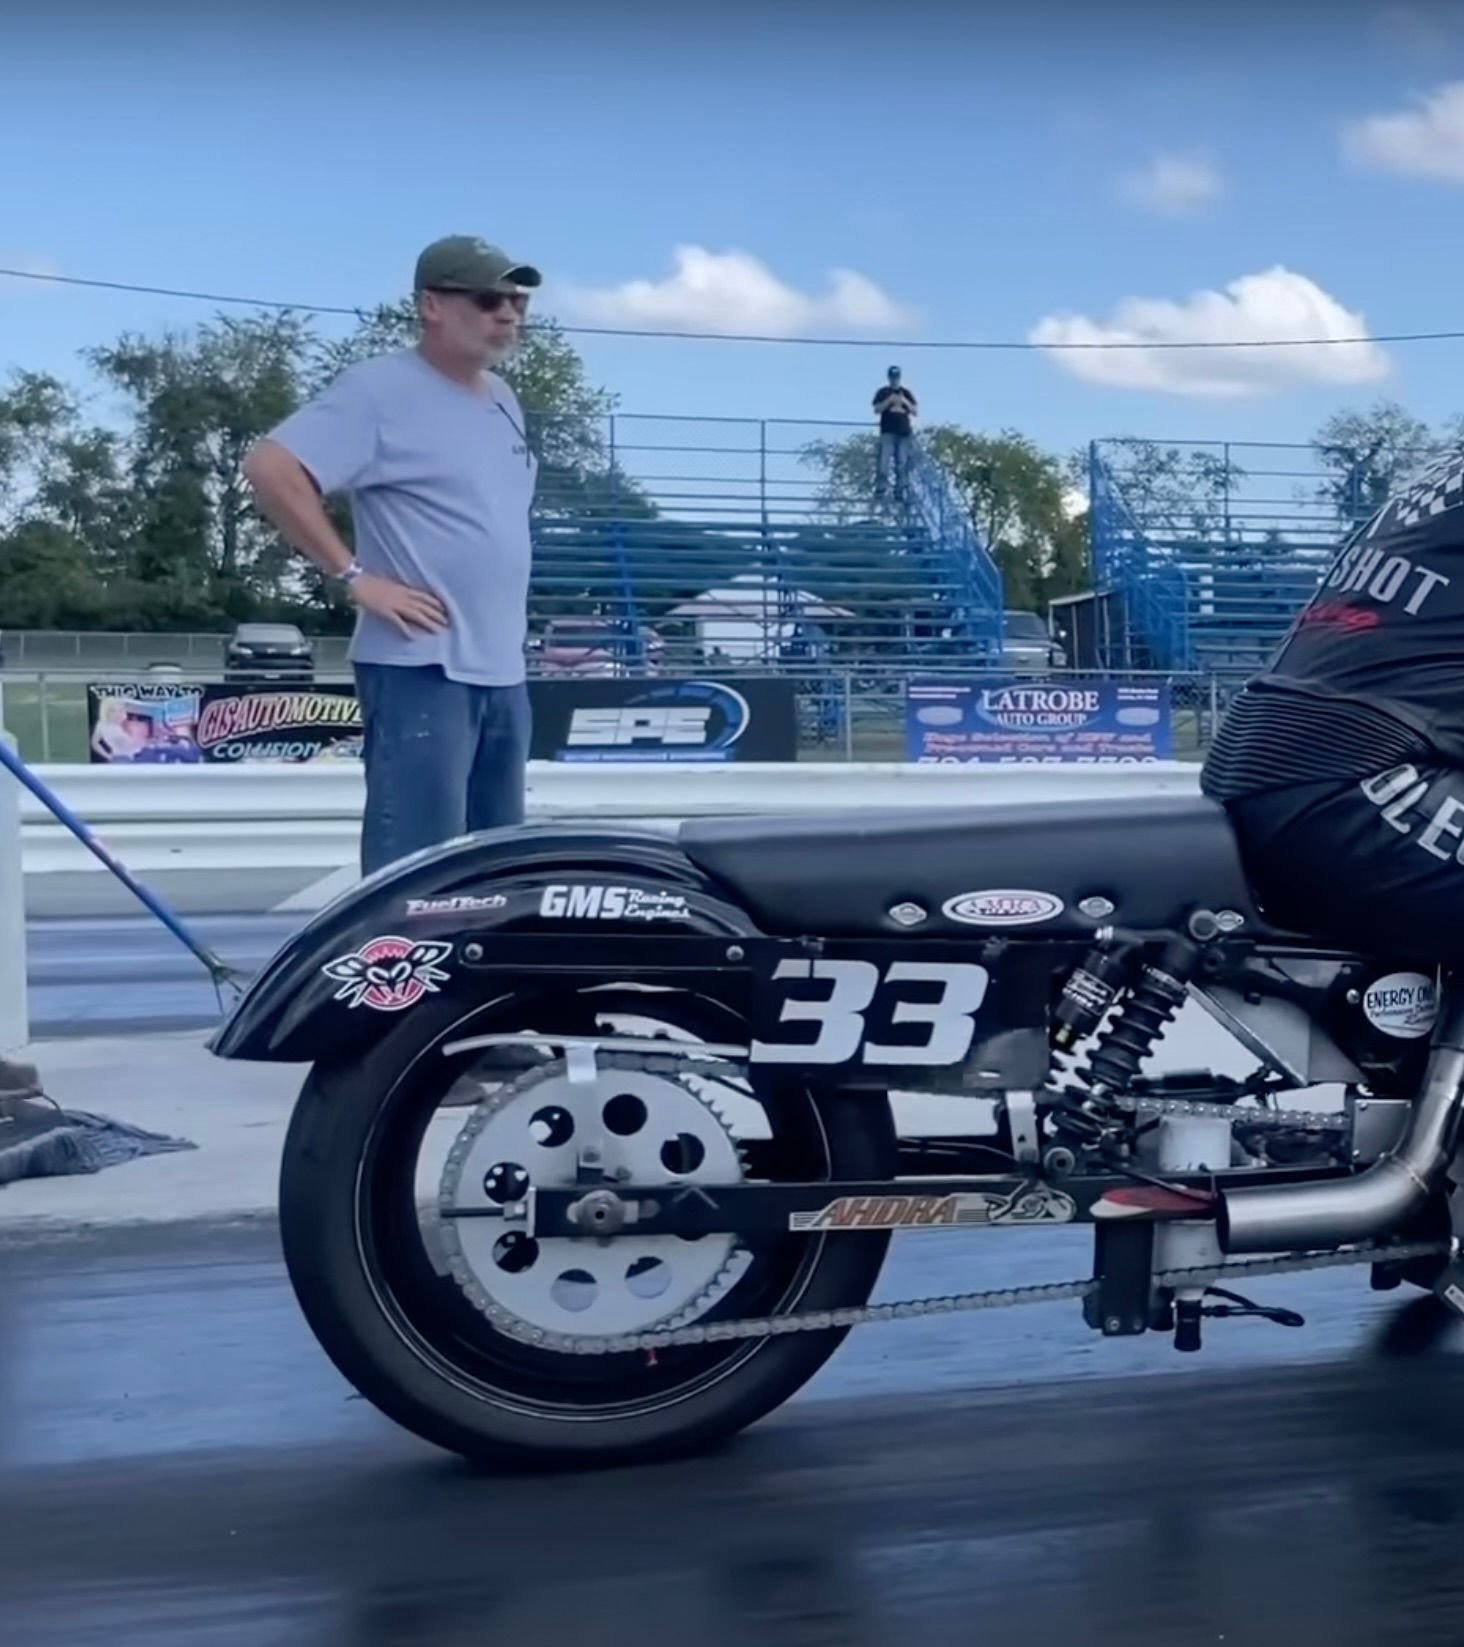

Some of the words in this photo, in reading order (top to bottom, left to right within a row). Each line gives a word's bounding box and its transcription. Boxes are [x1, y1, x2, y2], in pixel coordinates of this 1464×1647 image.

[139, 685, 175, 698] WAY
[981, 689, 1100, 712] LATROBE
[996, 712, 1034, 726] AUTO
[1036, 712, 1088, 727] GROUP
[406, 895, 507, 915] FuelTech
[539, 885, 628, 919] GMS
[625, 888, 686, 906] Racing
[623, 903, 691, 921] Engines
[1367, 986, 1415, 1009] ENERGY
[749, 958, 989, 1066] 33
[815, 1197, 959, 1226] AHDRA
